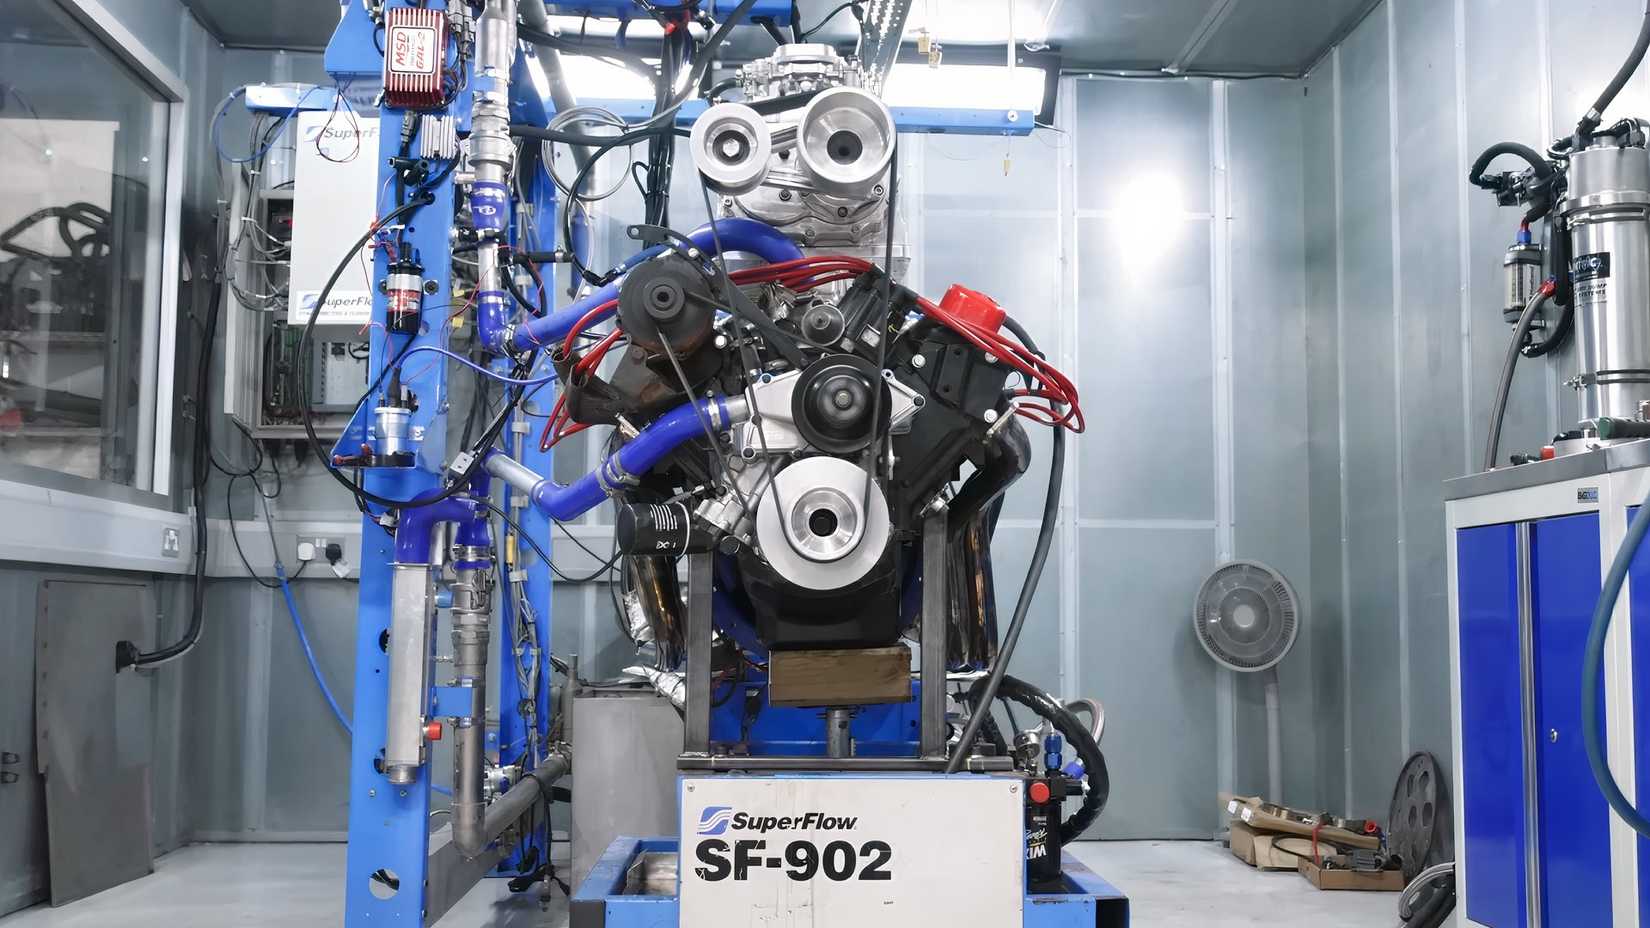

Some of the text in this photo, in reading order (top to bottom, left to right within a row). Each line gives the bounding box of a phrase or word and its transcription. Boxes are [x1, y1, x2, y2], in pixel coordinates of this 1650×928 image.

[395, 31, 407, 66] MSD
[731, 811, 858, 834] SuperFlow
[695, 839, 892, 882] SF-902
